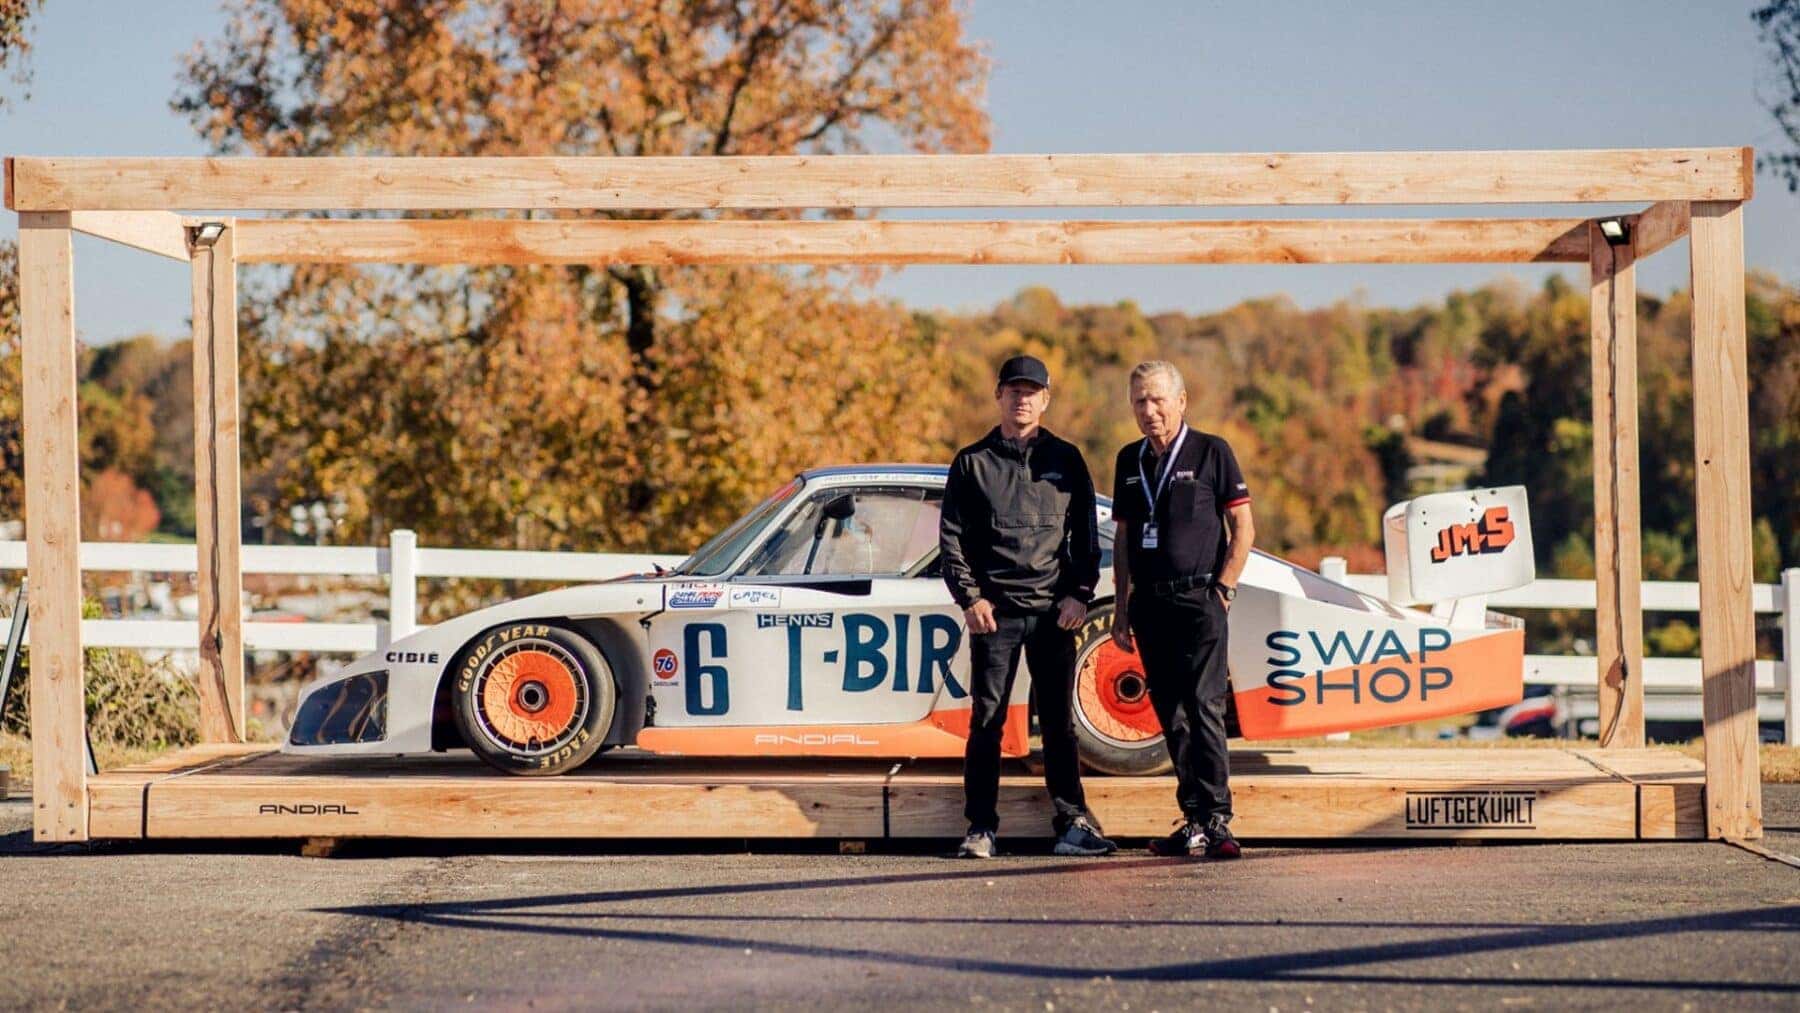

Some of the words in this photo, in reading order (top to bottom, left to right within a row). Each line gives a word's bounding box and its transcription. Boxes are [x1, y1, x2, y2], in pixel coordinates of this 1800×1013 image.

[733, 591, 777, 600] CAMEL
[656, 657, 675, 673] 76
[757, 612, 969, 712] T-BIR
[1266, 628, 1452, 667] SWAP
[684, 623, 730, 717] 6
[1266, 667, 1454, 706] SHOP
[540, 727, 591, 768] EAGLE
[755, 734, 880, 745] ANDIAL
[259, 804, 359, 815] ANDIAL
[1405, 791, 1537, 825] LUFTGEKÜHLT
